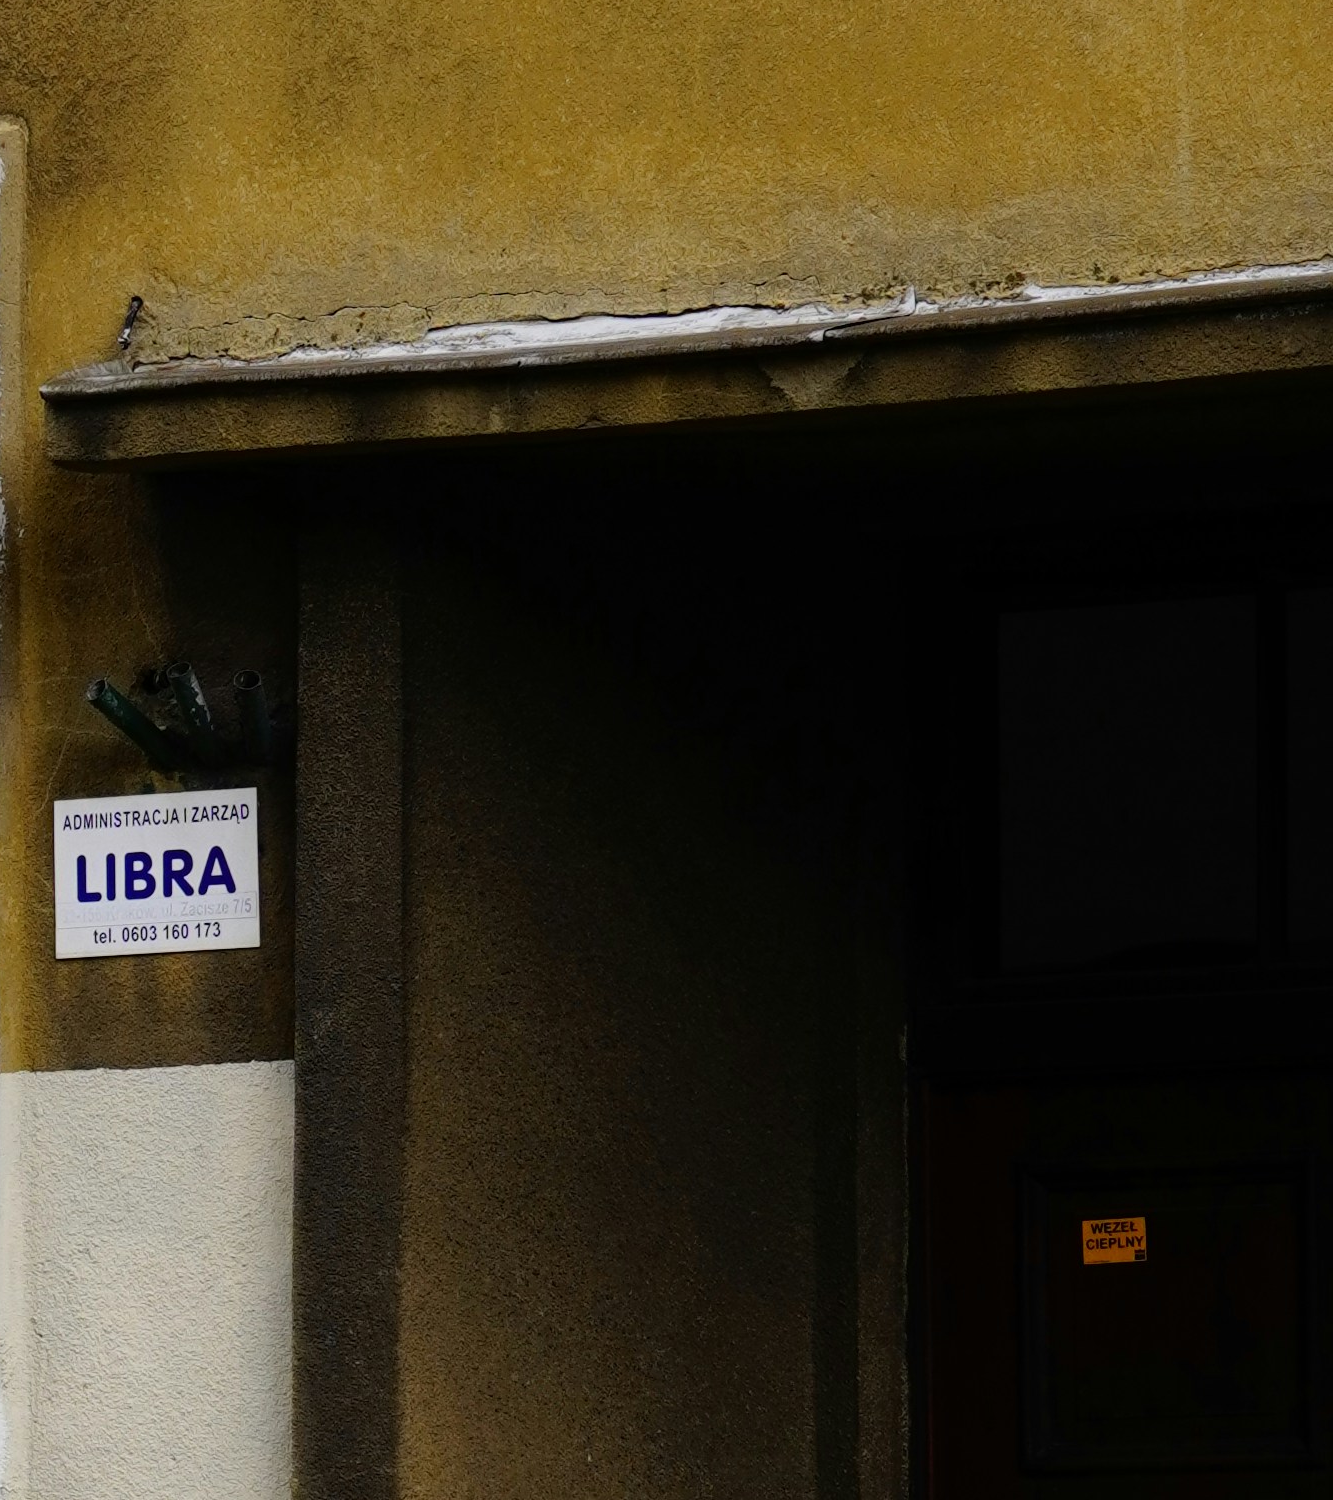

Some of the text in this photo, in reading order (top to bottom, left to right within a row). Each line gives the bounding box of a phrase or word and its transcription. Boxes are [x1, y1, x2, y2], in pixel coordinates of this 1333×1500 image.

[62, 803, 250, 831] ADMINISTRACJA I ZARZĄD
[76, 845, 237, 903] LIBRA
[180, 900, 229, 916] Zacisze
[233, 897, 253, 913] 7/5
[93, 921, 221, 944] tel. 0603 160 173
[1085, 1236, 1144, 1250] CIEPLNY
